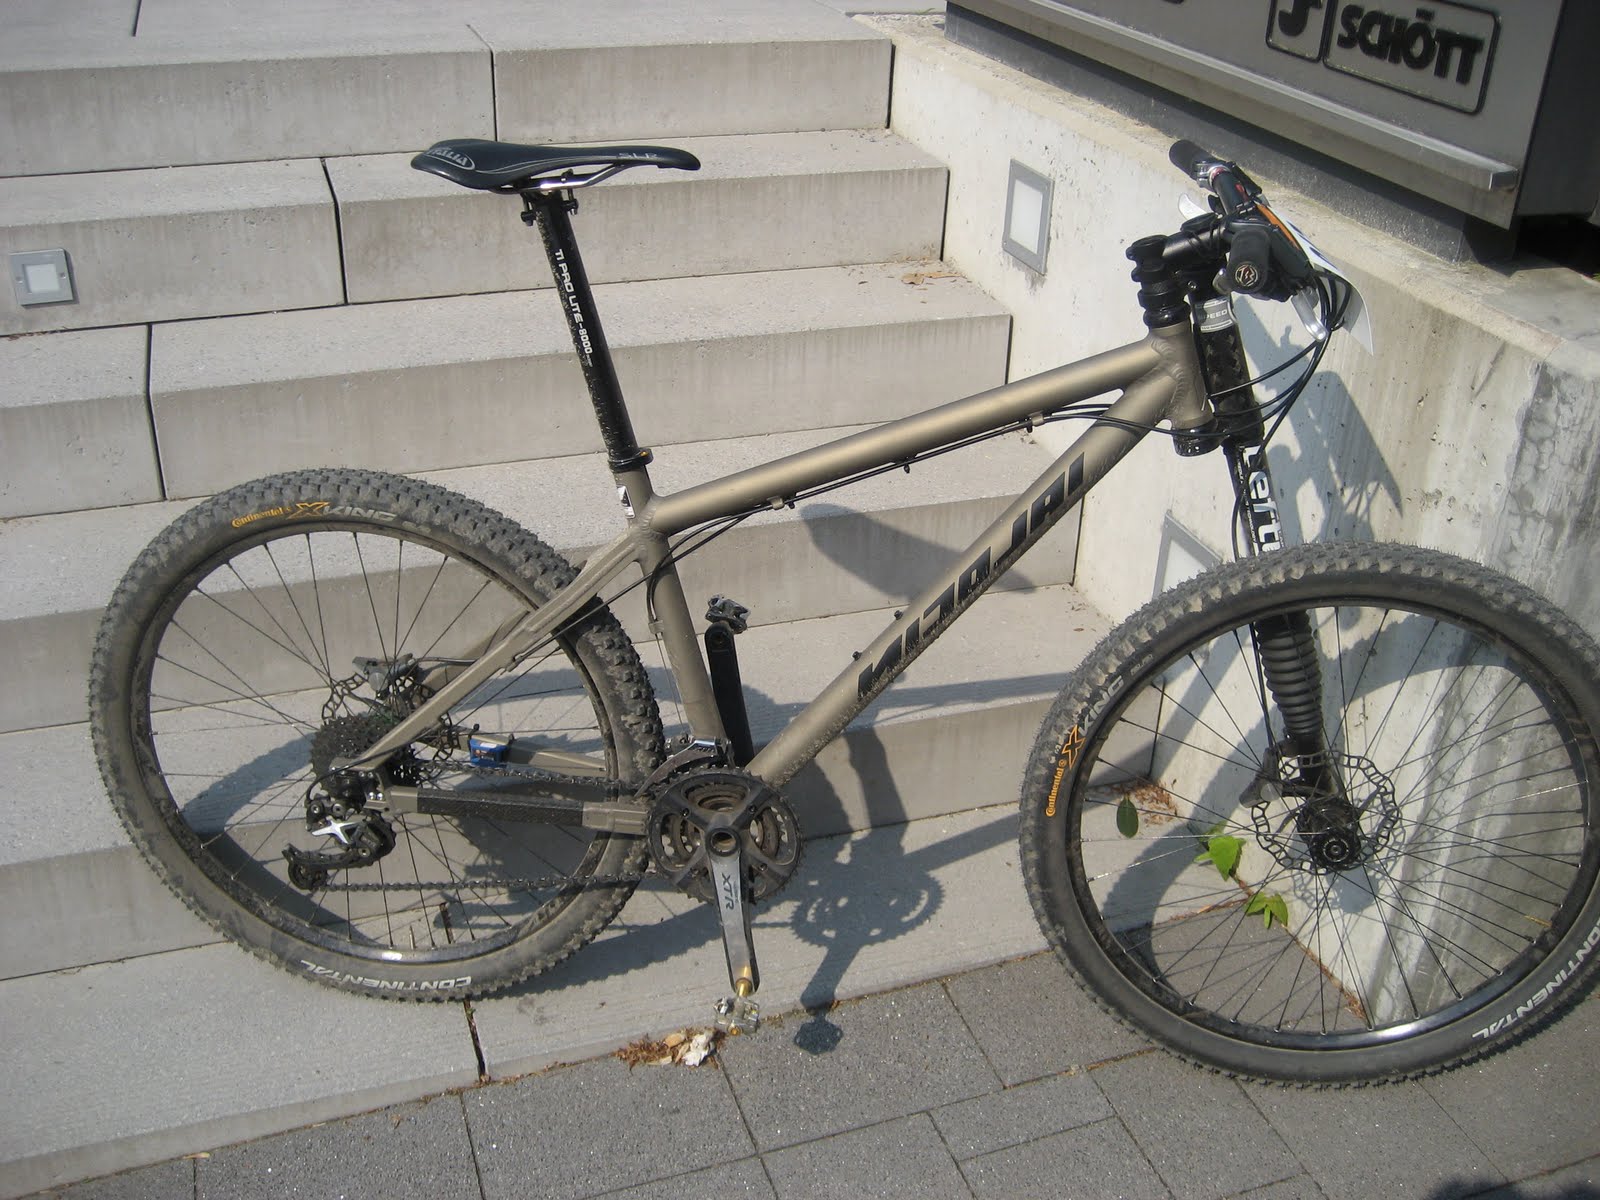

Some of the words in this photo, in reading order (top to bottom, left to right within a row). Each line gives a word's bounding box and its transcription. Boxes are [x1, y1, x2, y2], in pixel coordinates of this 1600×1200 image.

[1337, 4, 1484, 84] SCHÖTT
[558, 263, 575, 294] PRO
[231, 508, 284, 528] Continental
[1242, 445, 1281, 551] Left
[1045, 767, 1065, 817] Continental
[721, 872, 735, 911] XTR
[301, 960, 472, 991] CONTINENTAL
[1472, 917, 1600, 1039] ONTINENTAL
